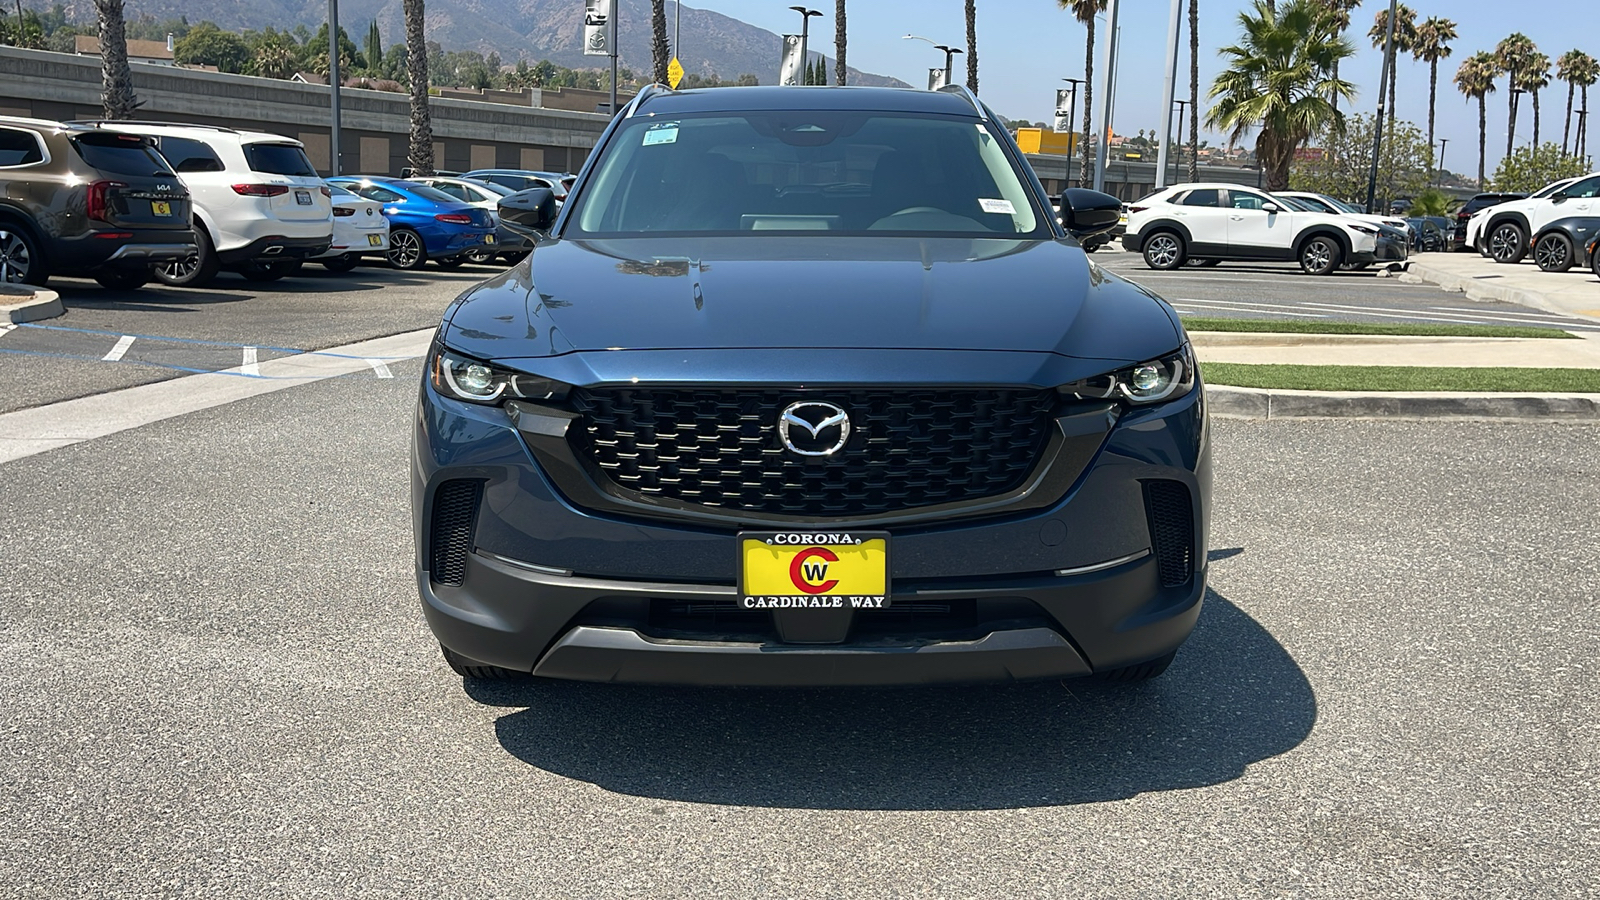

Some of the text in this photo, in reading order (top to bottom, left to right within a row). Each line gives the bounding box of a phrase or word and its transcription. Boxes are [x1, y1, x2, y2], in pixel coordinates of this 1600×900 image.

[774, 533, 854, 545] CORONA
[743, 596, 885, 608] CARDINALE WAY
